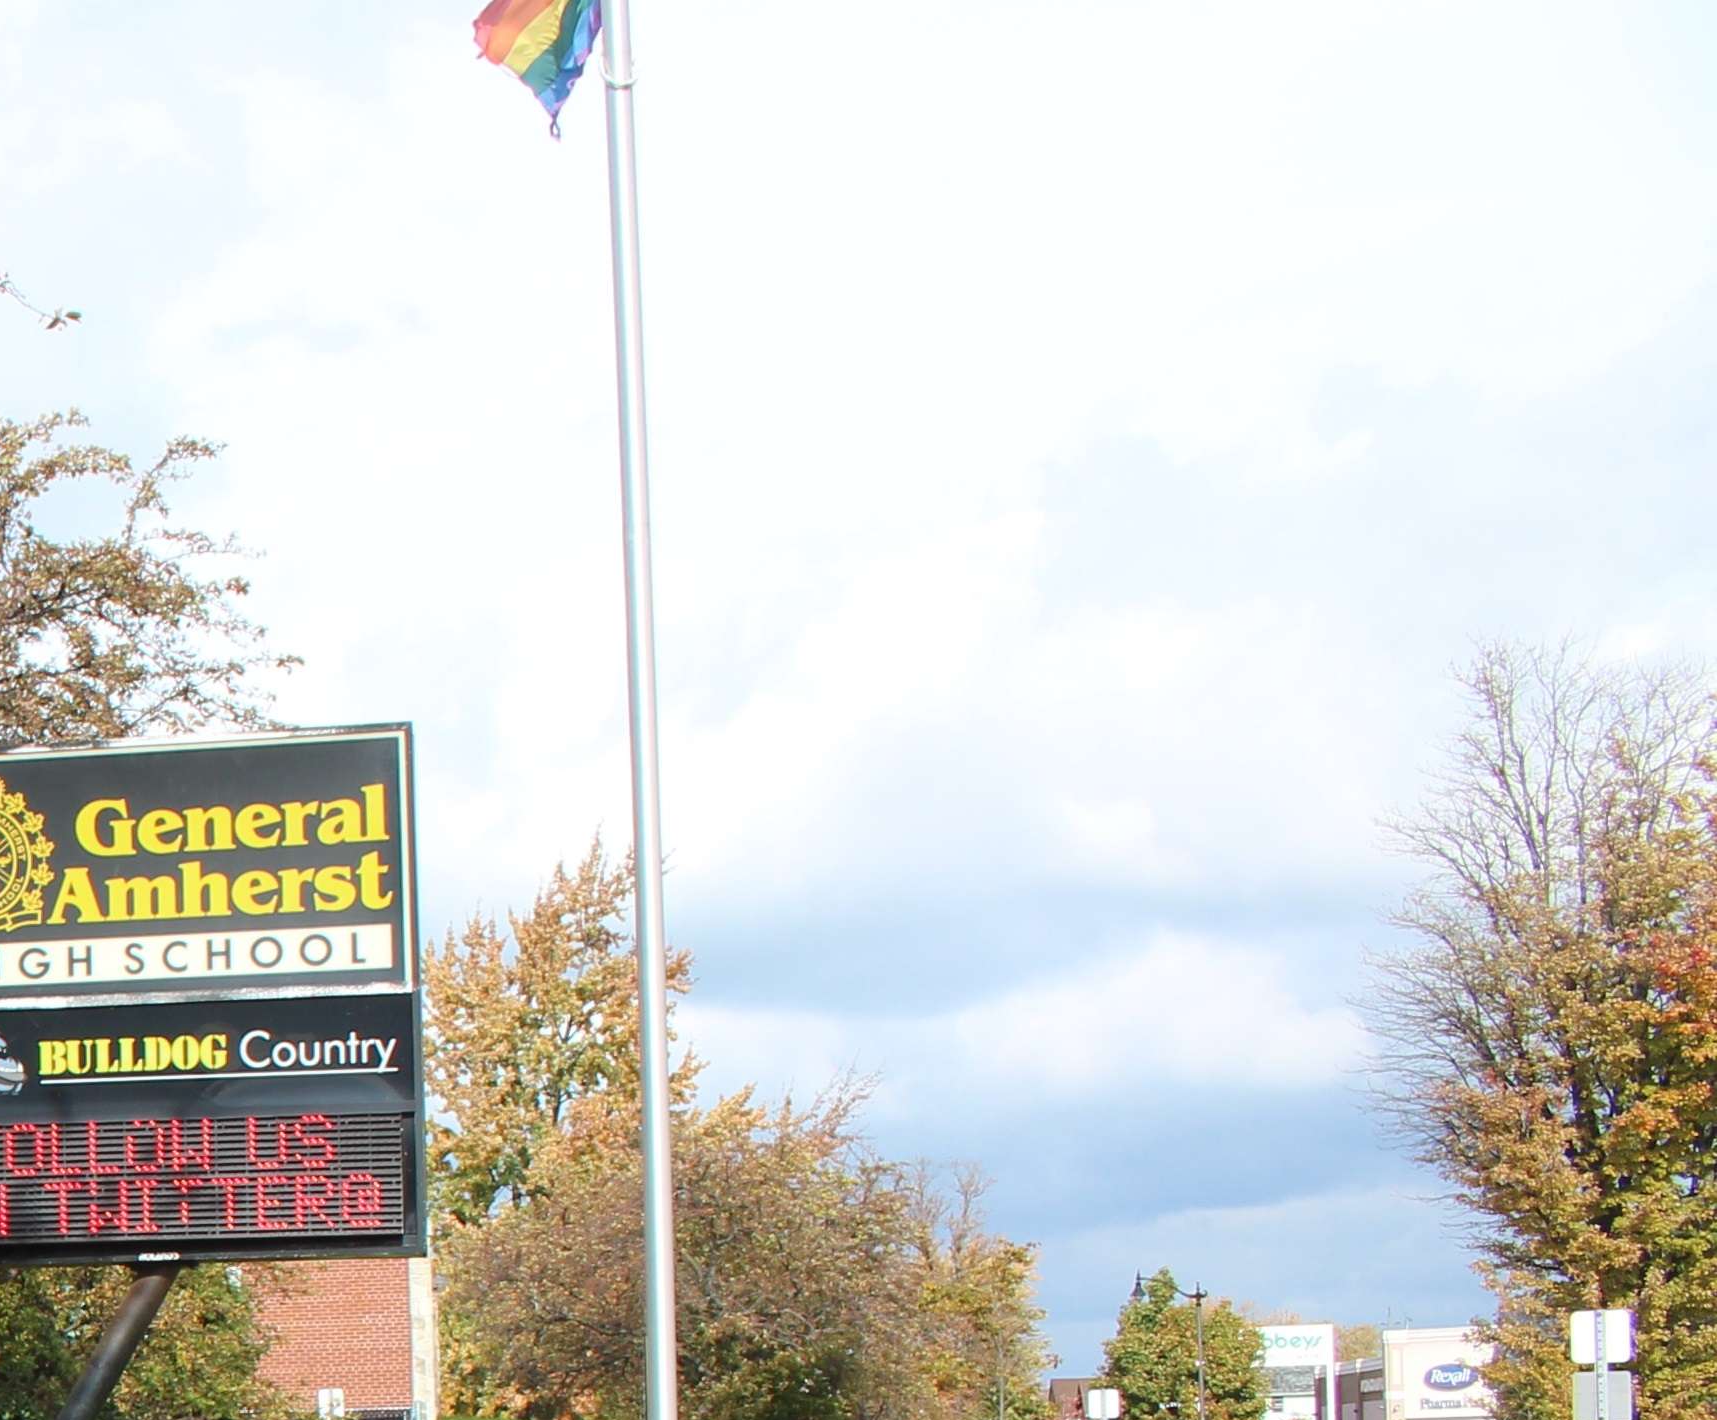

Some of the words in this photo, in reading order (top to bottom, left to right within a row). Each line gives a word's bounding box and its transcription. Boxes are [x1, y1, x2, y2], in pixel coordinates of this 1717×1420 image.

[75, 784, 390, 857] General
[47, 851, 394, 924] Amherst
[125, 932, 367, 974] SCHOOL
[39, 1034, 228, 1075] BULLDOG
[239, 1029, 397, 1073] Country
[246, 1114, 336, 1168] US
[1263, 1332, 1323, 1351] obeys
[1430, 1368, 1471, 1386] Rexall
